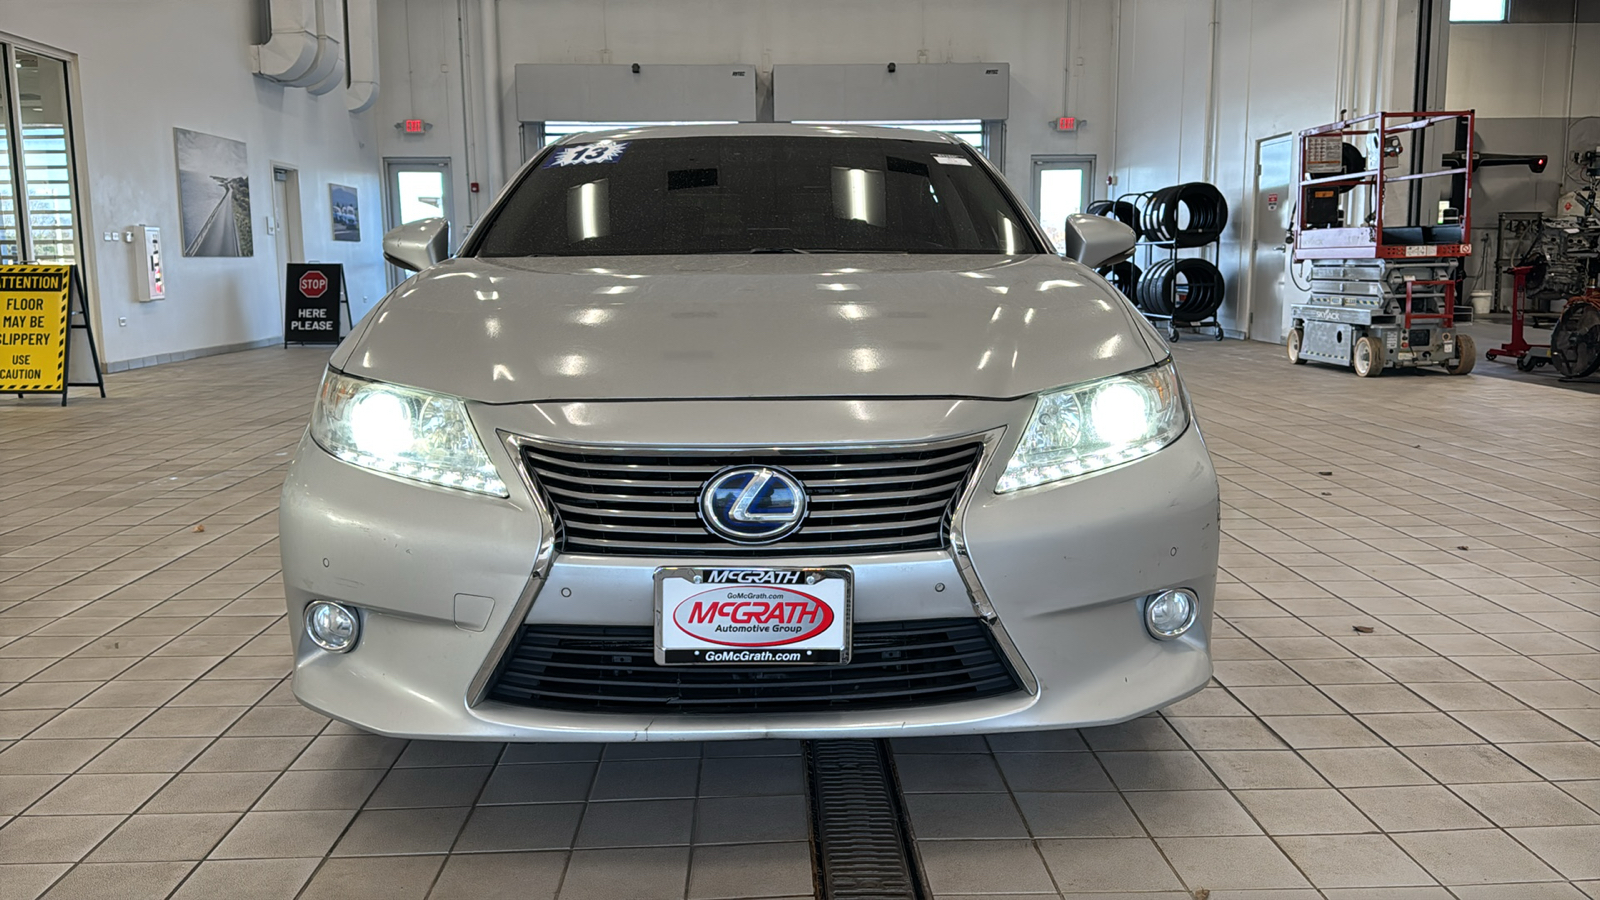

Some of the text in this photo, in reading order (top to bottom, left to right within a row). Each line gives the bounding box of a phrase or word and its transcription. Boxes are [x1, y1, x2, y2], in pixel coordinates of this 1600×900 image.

[572, 146, 609, 160] 13
[0, 276, 59, 289] TTENTION
[301, 279, 326, 289] STOP
[6, 298, 44, 310] FLOOR
[298, 308, 327, 318] HERE
[3, 316, 45, 328] MAY BE
[291, 321, 333, 330] PLEASE
[12, 355, 31, 365] USE
[0, 369, 41, 380] CAUTION
[727, 592, 784, 600] GoMcGrath.com
[715, 624, 803, 634] Automotive Group
[705, 651, 801, 662] GoMcGrath.com
